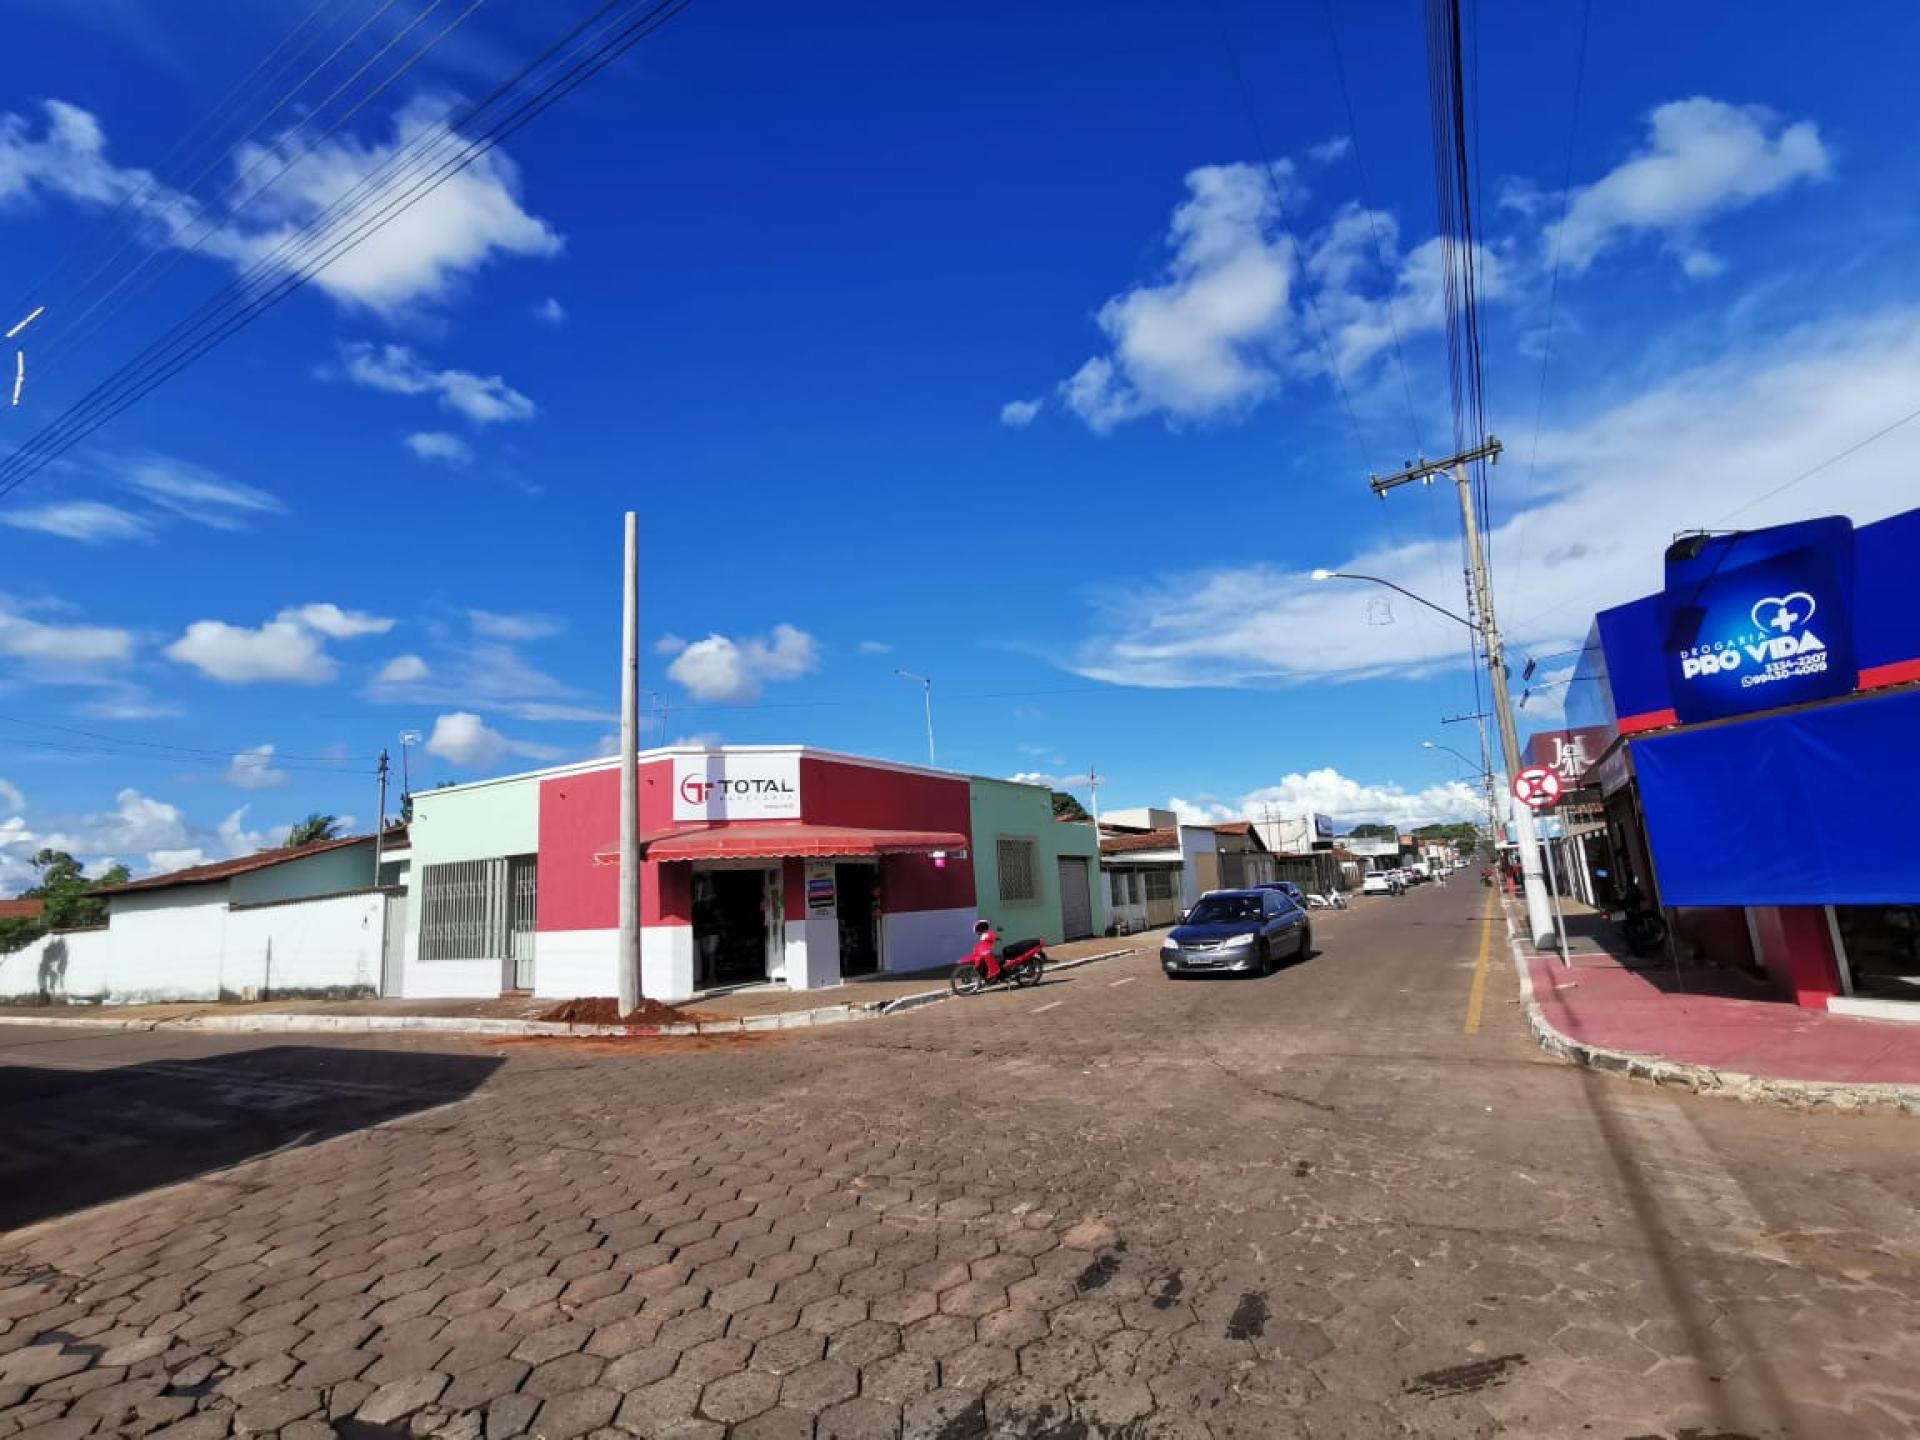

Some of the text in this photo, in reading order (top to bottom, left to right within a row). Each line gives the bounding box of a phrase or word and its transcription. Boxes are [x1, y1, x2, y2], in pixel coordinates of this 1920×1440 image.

[1682, 630, 1825, 679] PRO VIDA
[717, 779, 795, 794] TOTAL
